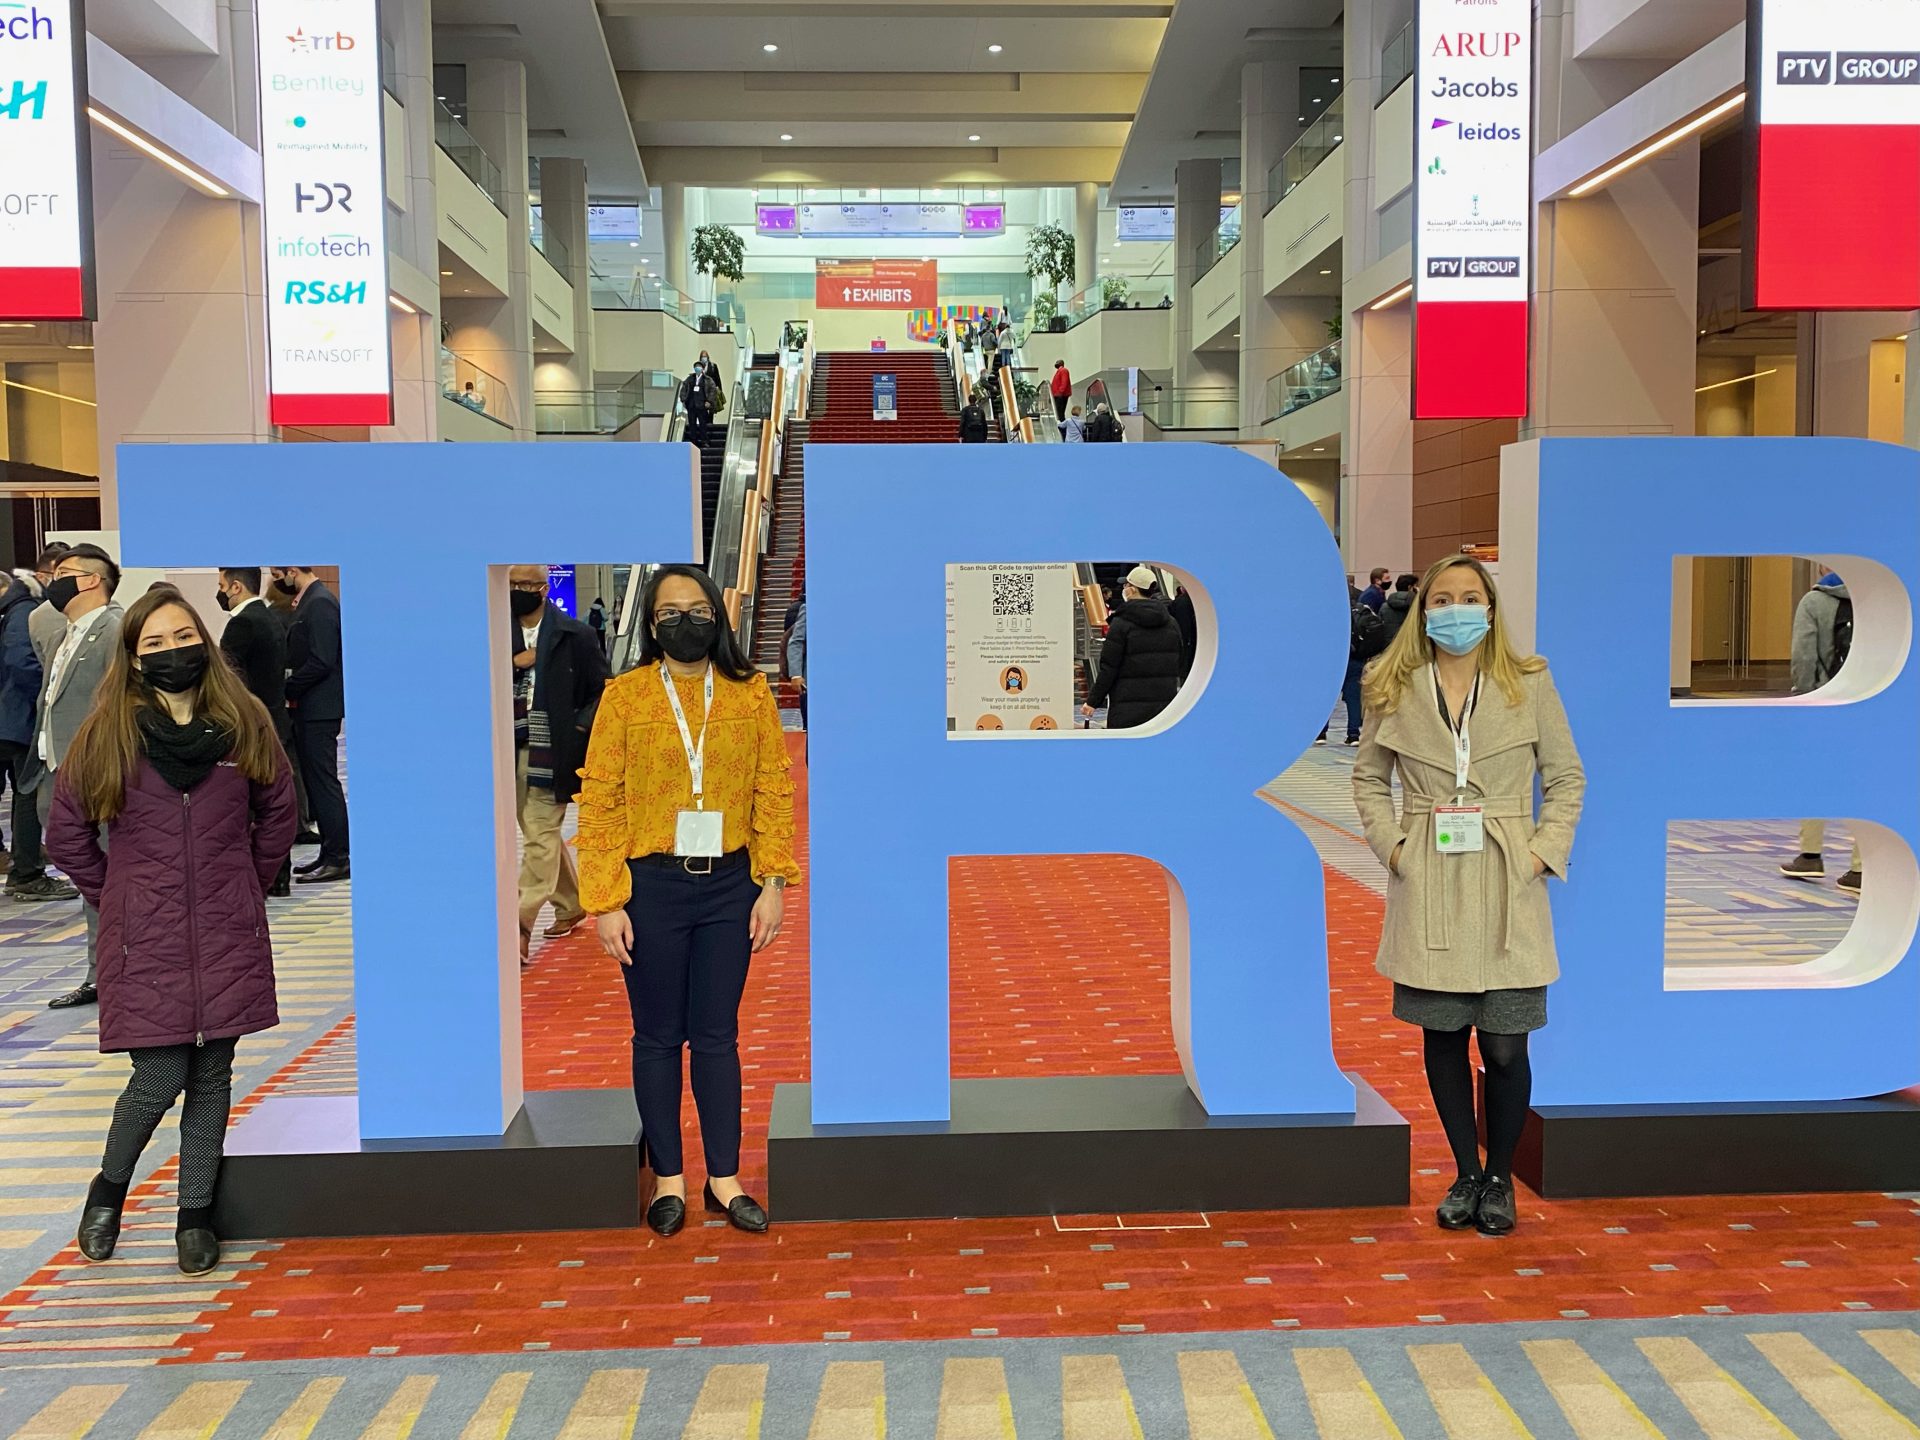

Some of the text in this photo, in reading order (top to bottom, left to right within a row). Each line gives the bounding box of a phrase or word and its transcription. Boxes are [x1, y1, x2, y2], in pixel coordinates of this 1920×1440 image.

[0, 7, 52, 39] ch
[1432, 33, 1520, 57] ARUP
[1783, 59, 1918, 78] PTV GROUP
[272, 74, 364, 96] Bentley
[1432, 77, 1518, 97] Jacobs
[1459, 122, 1520, 140] leidos
[277, 143, 368, 151] Reimagined Mobility
[0, 194, 58, 214] OFT
[296, 183, 352, 213] HDR
[278, 236, 370, 256] infotech
[1430, 261, 1516, 273] PTV GROUP
[285, 281, 366, 304] RS&H
[853, 288, 912, 302] EXHIBITS
[283, 349, 372, 362] TRANSOFT
